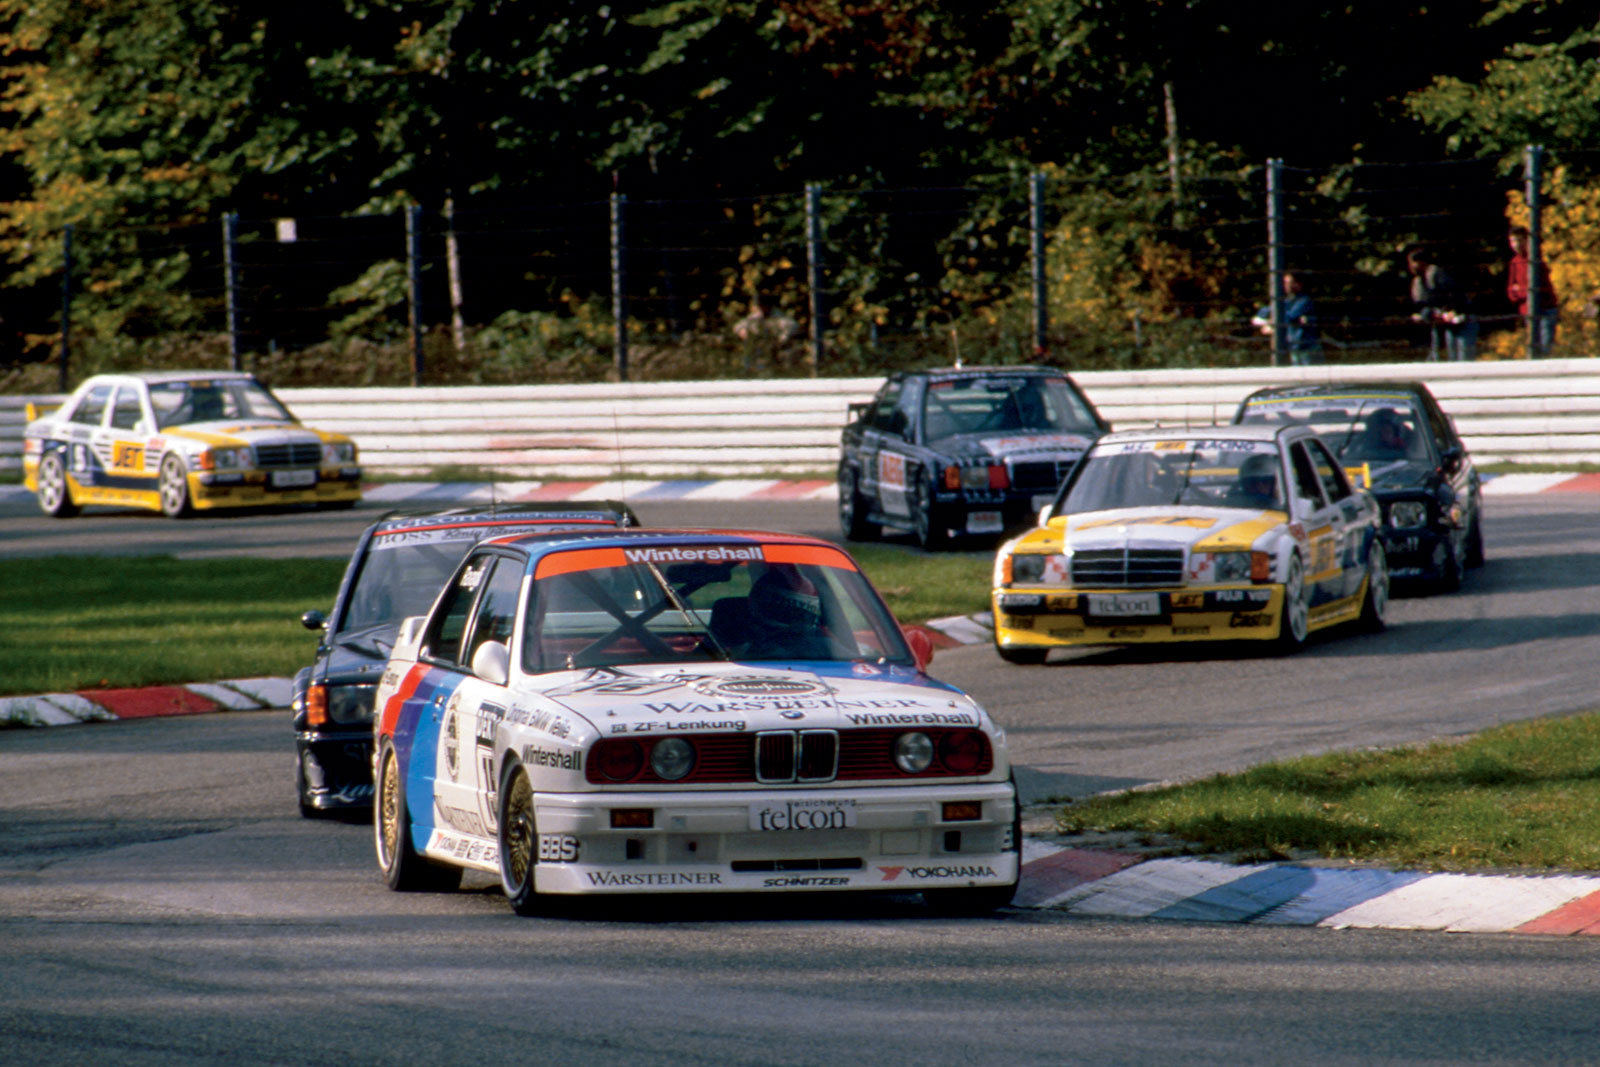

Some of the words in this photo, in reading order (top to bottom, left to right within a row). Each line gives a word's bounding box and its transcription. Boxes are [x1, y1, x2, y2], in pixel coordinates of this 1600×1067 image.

[1195, 440, 1256, 451] RACING
[115, 447, 143, 468] JET
[377, 530, 432, 547] BOSS
[625, 546, 764, 563] Wintershall
[1216, 590, 1244, 601] FUJI
[1100, 596, 1150, 612] telcon
[641, 700, 931, 714] WARSTEINER
[633, 720, 747, 732] ZF-Lenkung
[845, 711, 975, 726] Wintershall
[522, 743, 582, 771] Wintershall
[760, 802, 846, 831] telcon
[538, 834, 580, 863] BBS
[587, 871, 722, 886] WARSTEINER
[904, 865, 998, 880] YOKOHAMA
[763, 876, 851, 888] SCHNITZER
